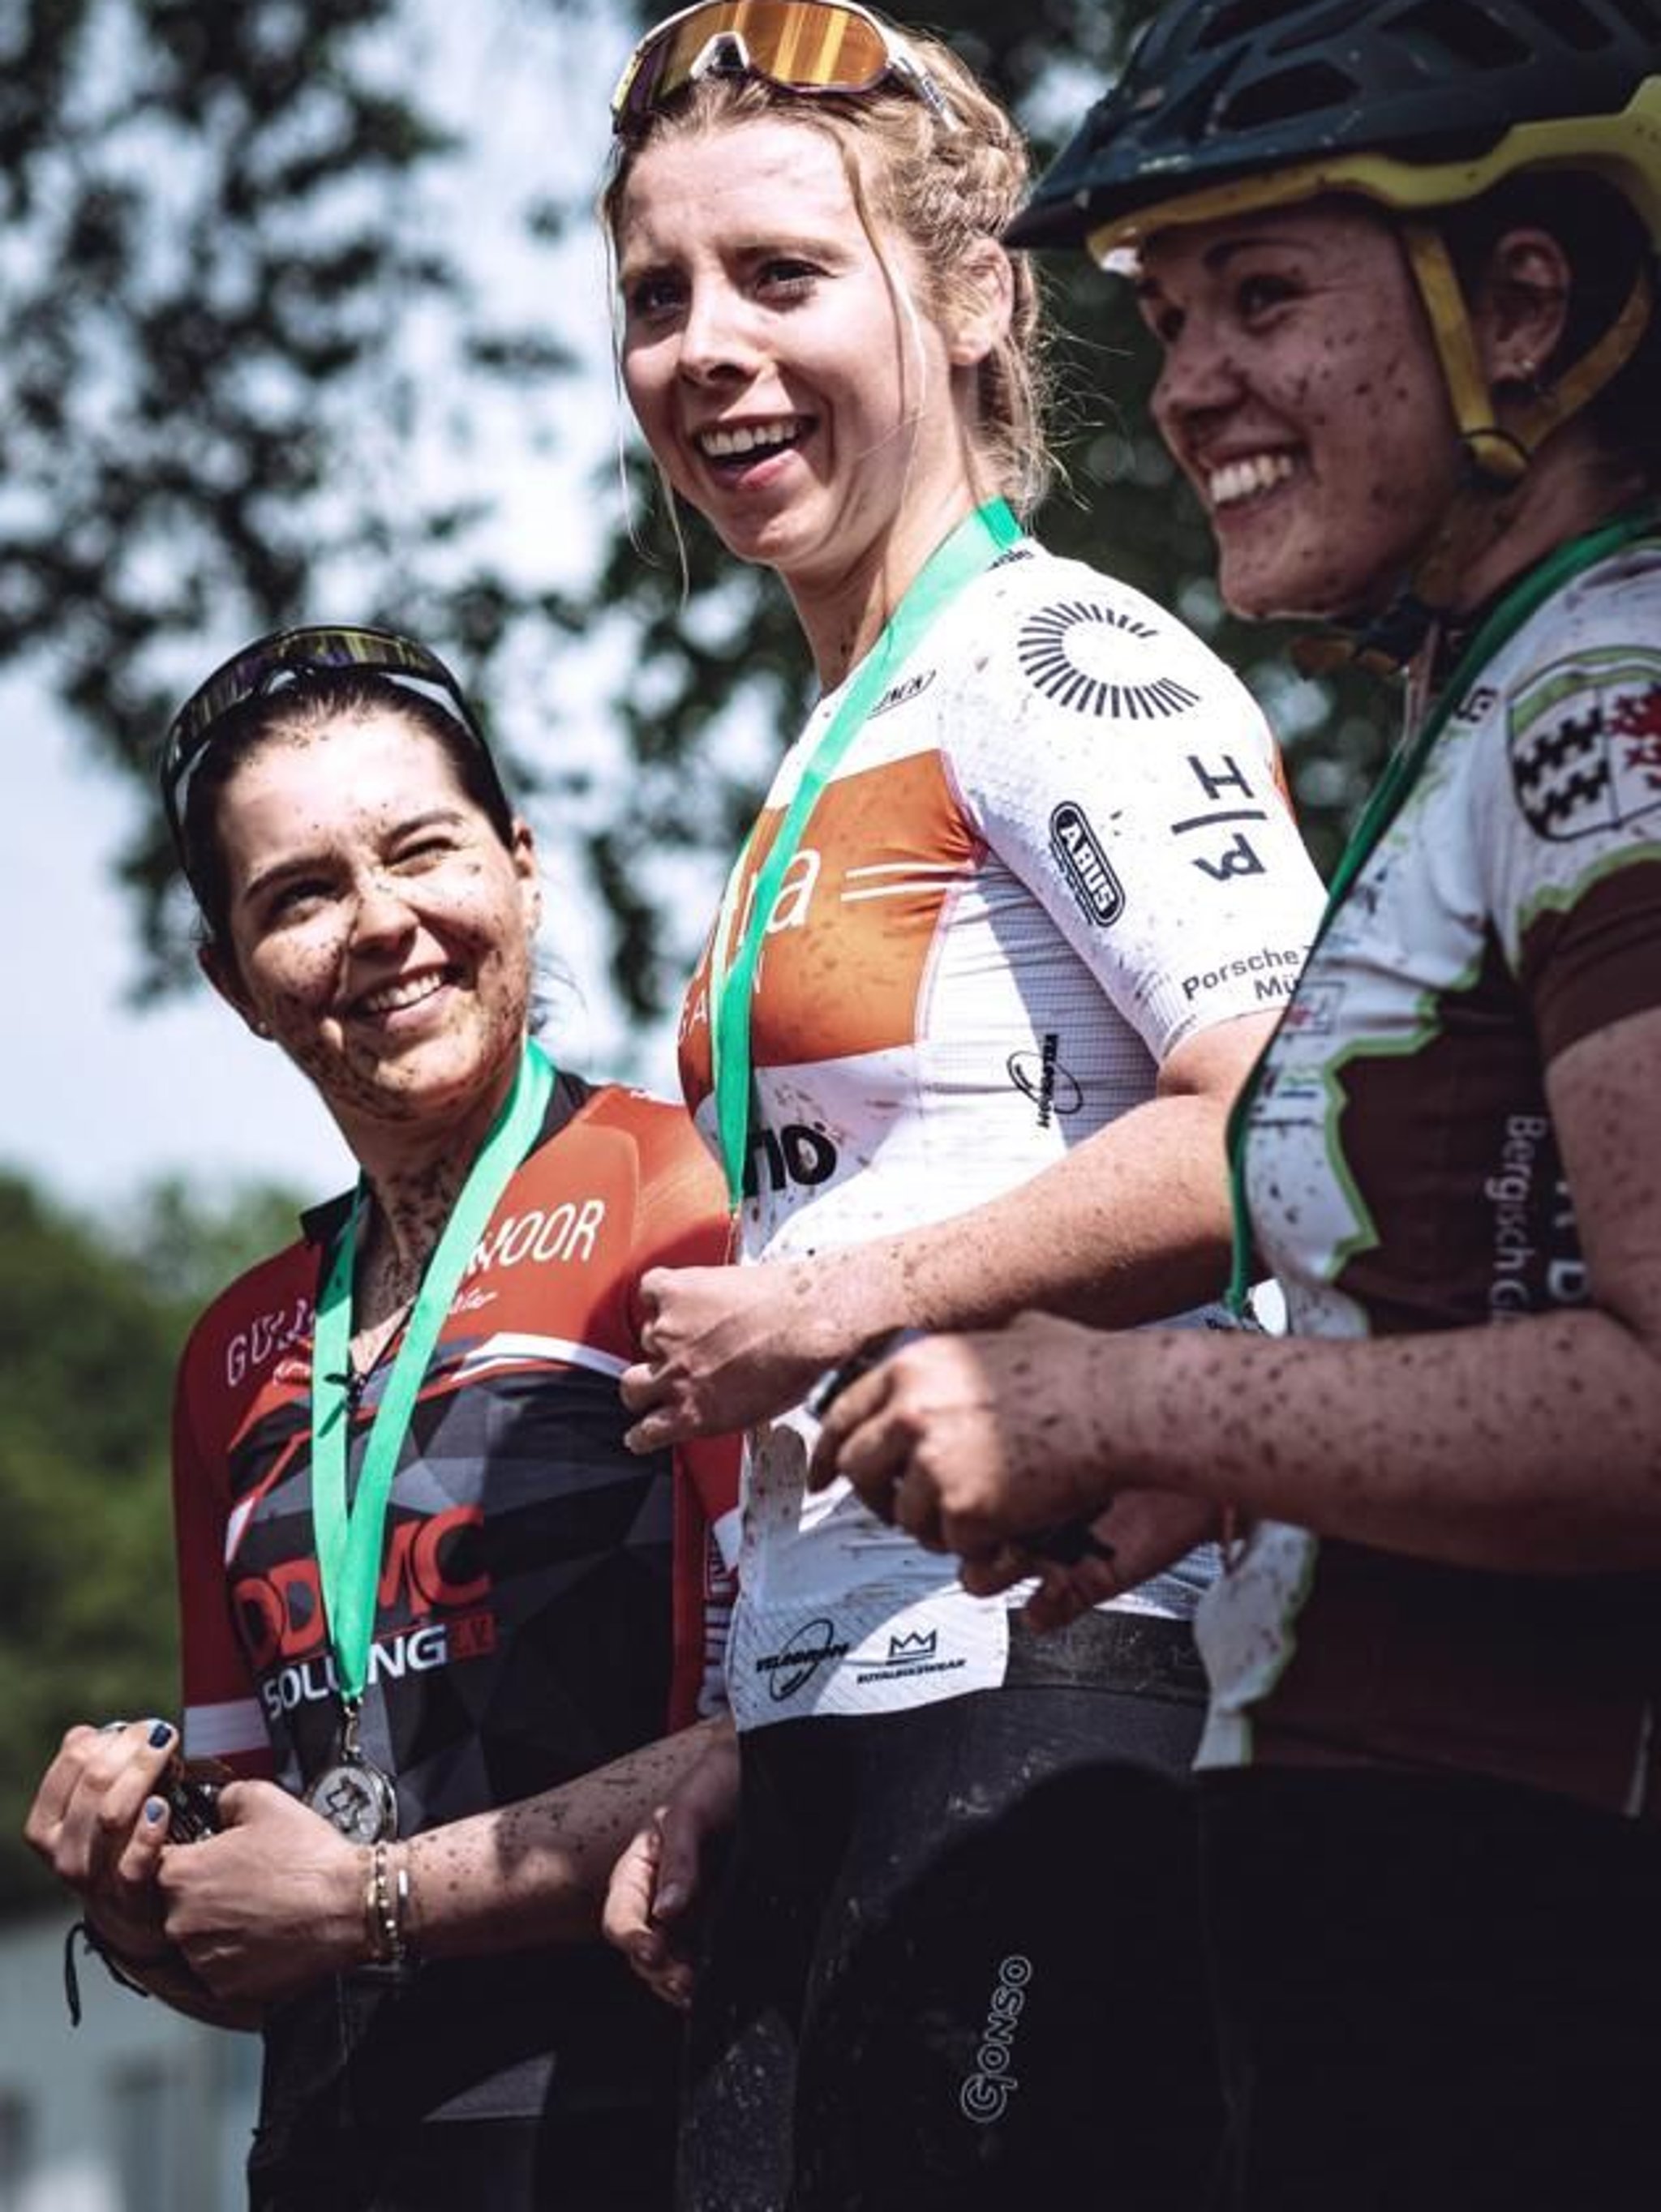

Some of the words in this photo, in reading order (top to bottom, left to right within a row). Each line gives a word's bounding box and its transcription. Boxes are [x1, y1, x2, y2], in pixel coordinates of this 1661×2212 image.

[1058, 821, 1117, 913] ABUS
[1182, 947, 1300, 1001] Porsche
[1484, 1114, 1547, 1271] Bergisch
[960, 1954, 1033, 2124] GONSO
